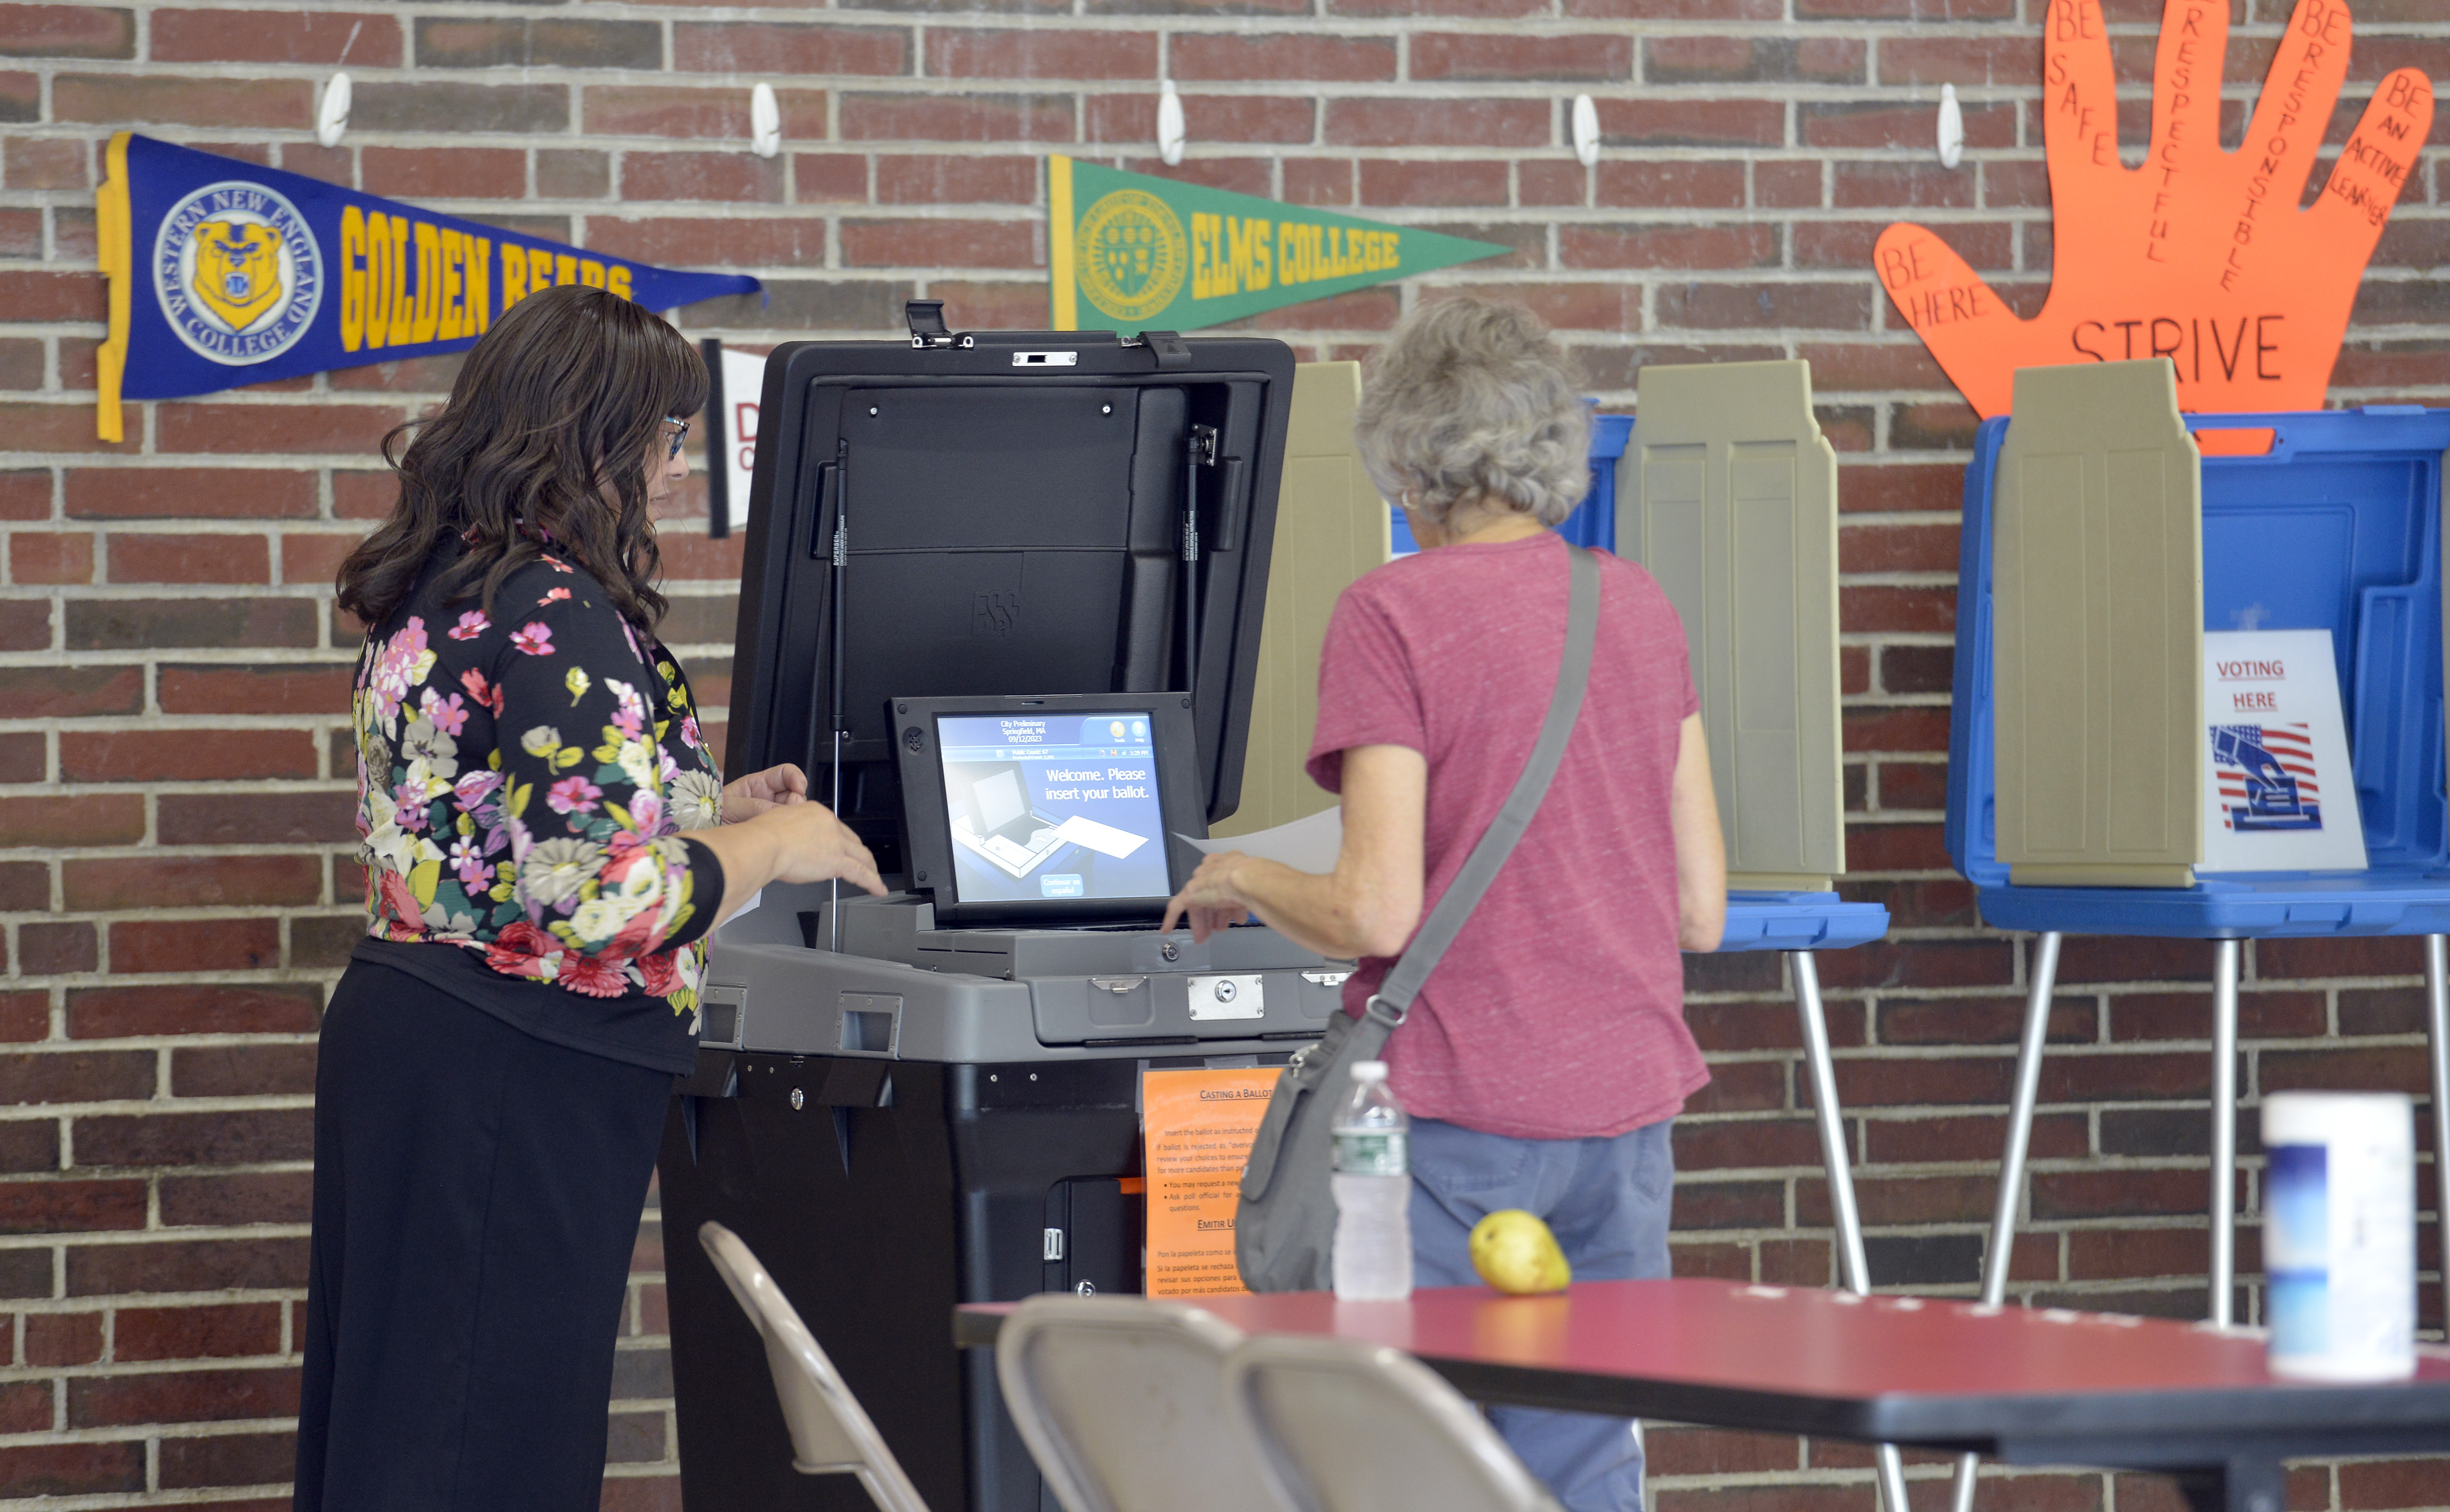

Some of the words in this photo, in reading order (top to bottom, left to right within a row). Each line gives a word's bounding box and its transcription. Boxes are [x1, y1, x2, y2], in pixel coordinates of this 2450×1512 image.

[2055, 0, 2099, 42] BE
[2301, 0, 2351, 46] BE
[2386, 73, 2431, 119] BE
[2048, 53, 2110, 167] SAFE
[2146, 8, 2203, 263] RESPECTFUL
[2377, 115, 2410, 141] AN
[2220, 43, 2323, 292] RESPONSIBLE
[2344, 136, 2406, 188] ACTIVE
[212, 190, 269, 212] NEW
[163, 200, 208, 316] WESTERN
[270, 206, 316, 324] ENGLAND
[1191, 211, 1271, 301] ELMS
[1278, 220, 1401, 286] COLLEGE
[1882, 237, 1934, 290] BE
[340, 204, 491, 353] GOLDEN
[1910, 281, 1989, 326] HERE
[185, 317, 292, 357] COLLEGE
[2072, 315, 2284, 383] STRIVE
[2217, 660, 2284, 677] VOTING
[2233, 692, 2276, 708] HERE
[1001, 720, 1013, 729] City
[1013, 720, 1046, 728] Preliminary
[1002, 727, 1035, 736] Springfield,
[1008, 735, 1042, 744] 09/12/2023
[1046, 768, 1104, 782] Welcome.
[1108, 767, 1146, 781] Please
[1045, 788, 1080, 800] insert
[1081, 789, 1110, 802] your
[1112, 785, 1149, 799] ballot.
[1051, 887, 1075, 896] español
[1200, 1090, 1234, 1099] CASTING
[1243, 1089, 1272, 1098] BALLOT
[1191, 1143, 1216, 1151] rejected
[1198, 1220, 1225, 1229] EMITIR
[1178, 1249, 1205, 1258] papeleta
[1172, 1264, 1199, 1272] papeleta
[1223, 1275, 1237, 1283] para
